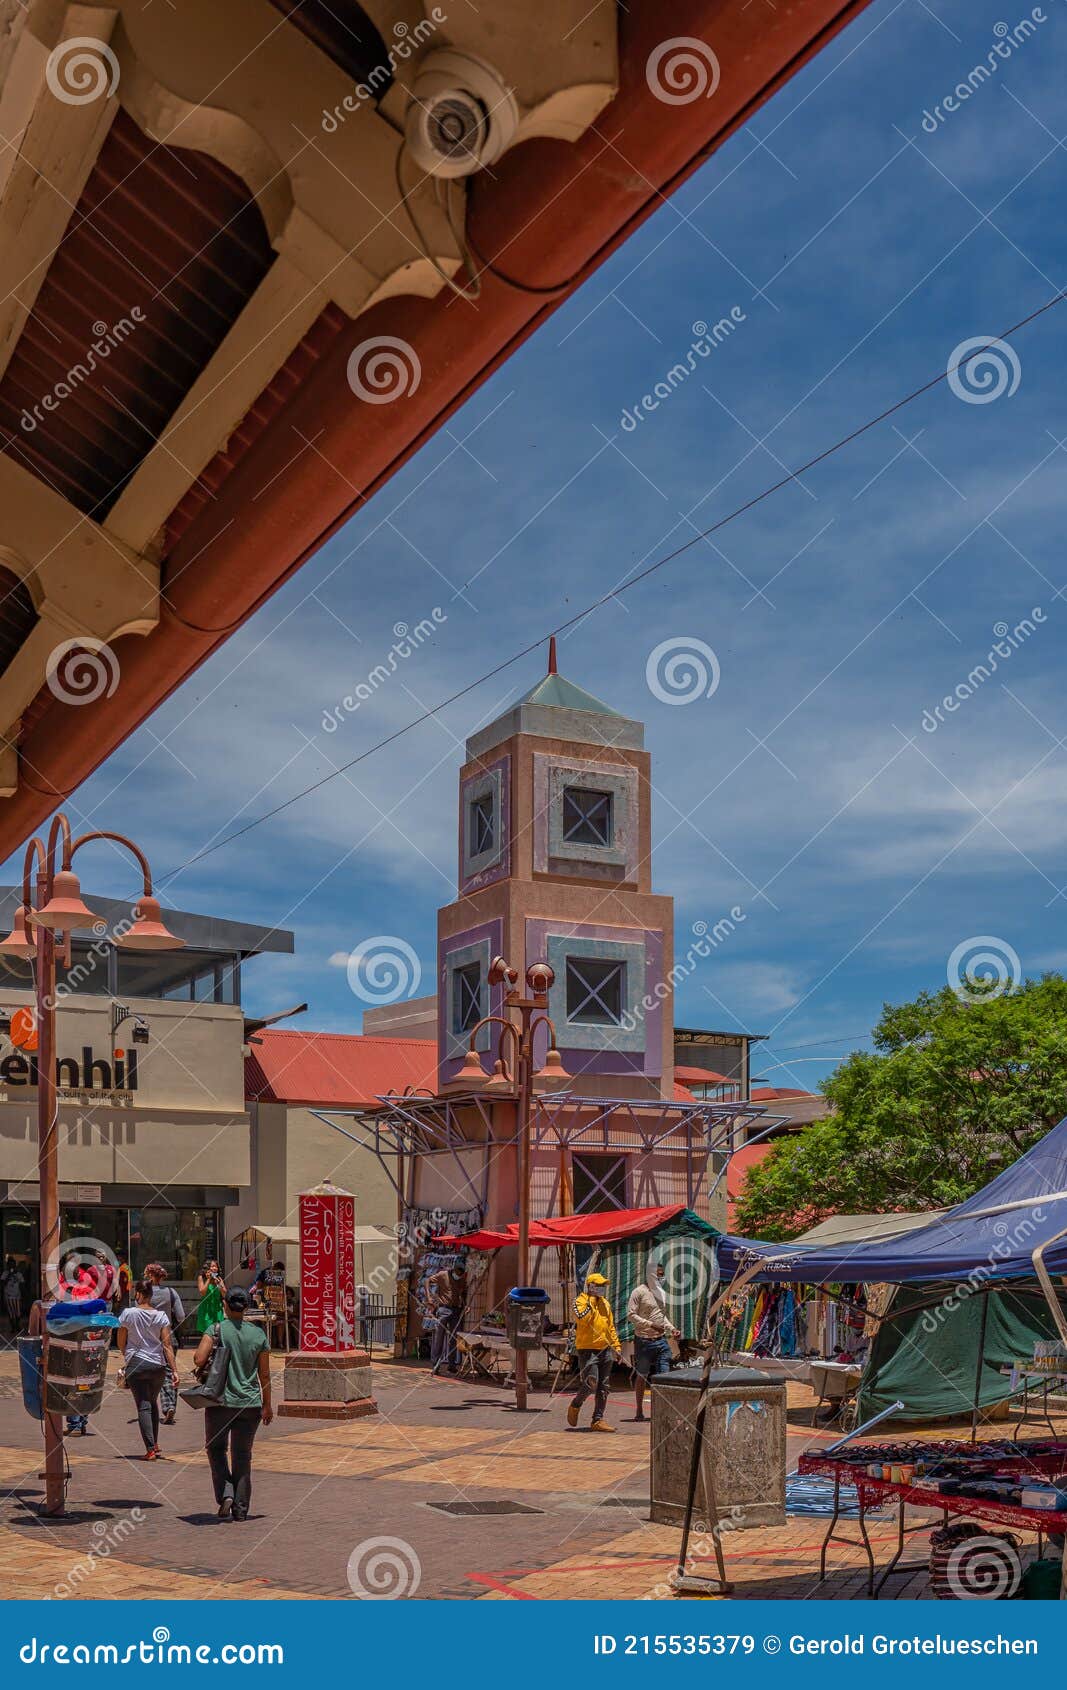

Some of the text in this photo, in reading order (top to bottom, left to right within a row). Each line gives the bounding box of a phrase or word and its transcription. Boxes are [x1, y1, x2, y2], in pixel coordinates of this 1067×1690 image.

[0, 1044, 138, 1090] enhil
[303, 1200, 319, 1348] OPTIC EXCLUSIVE
[323, 1273, 334, 1298] Park
